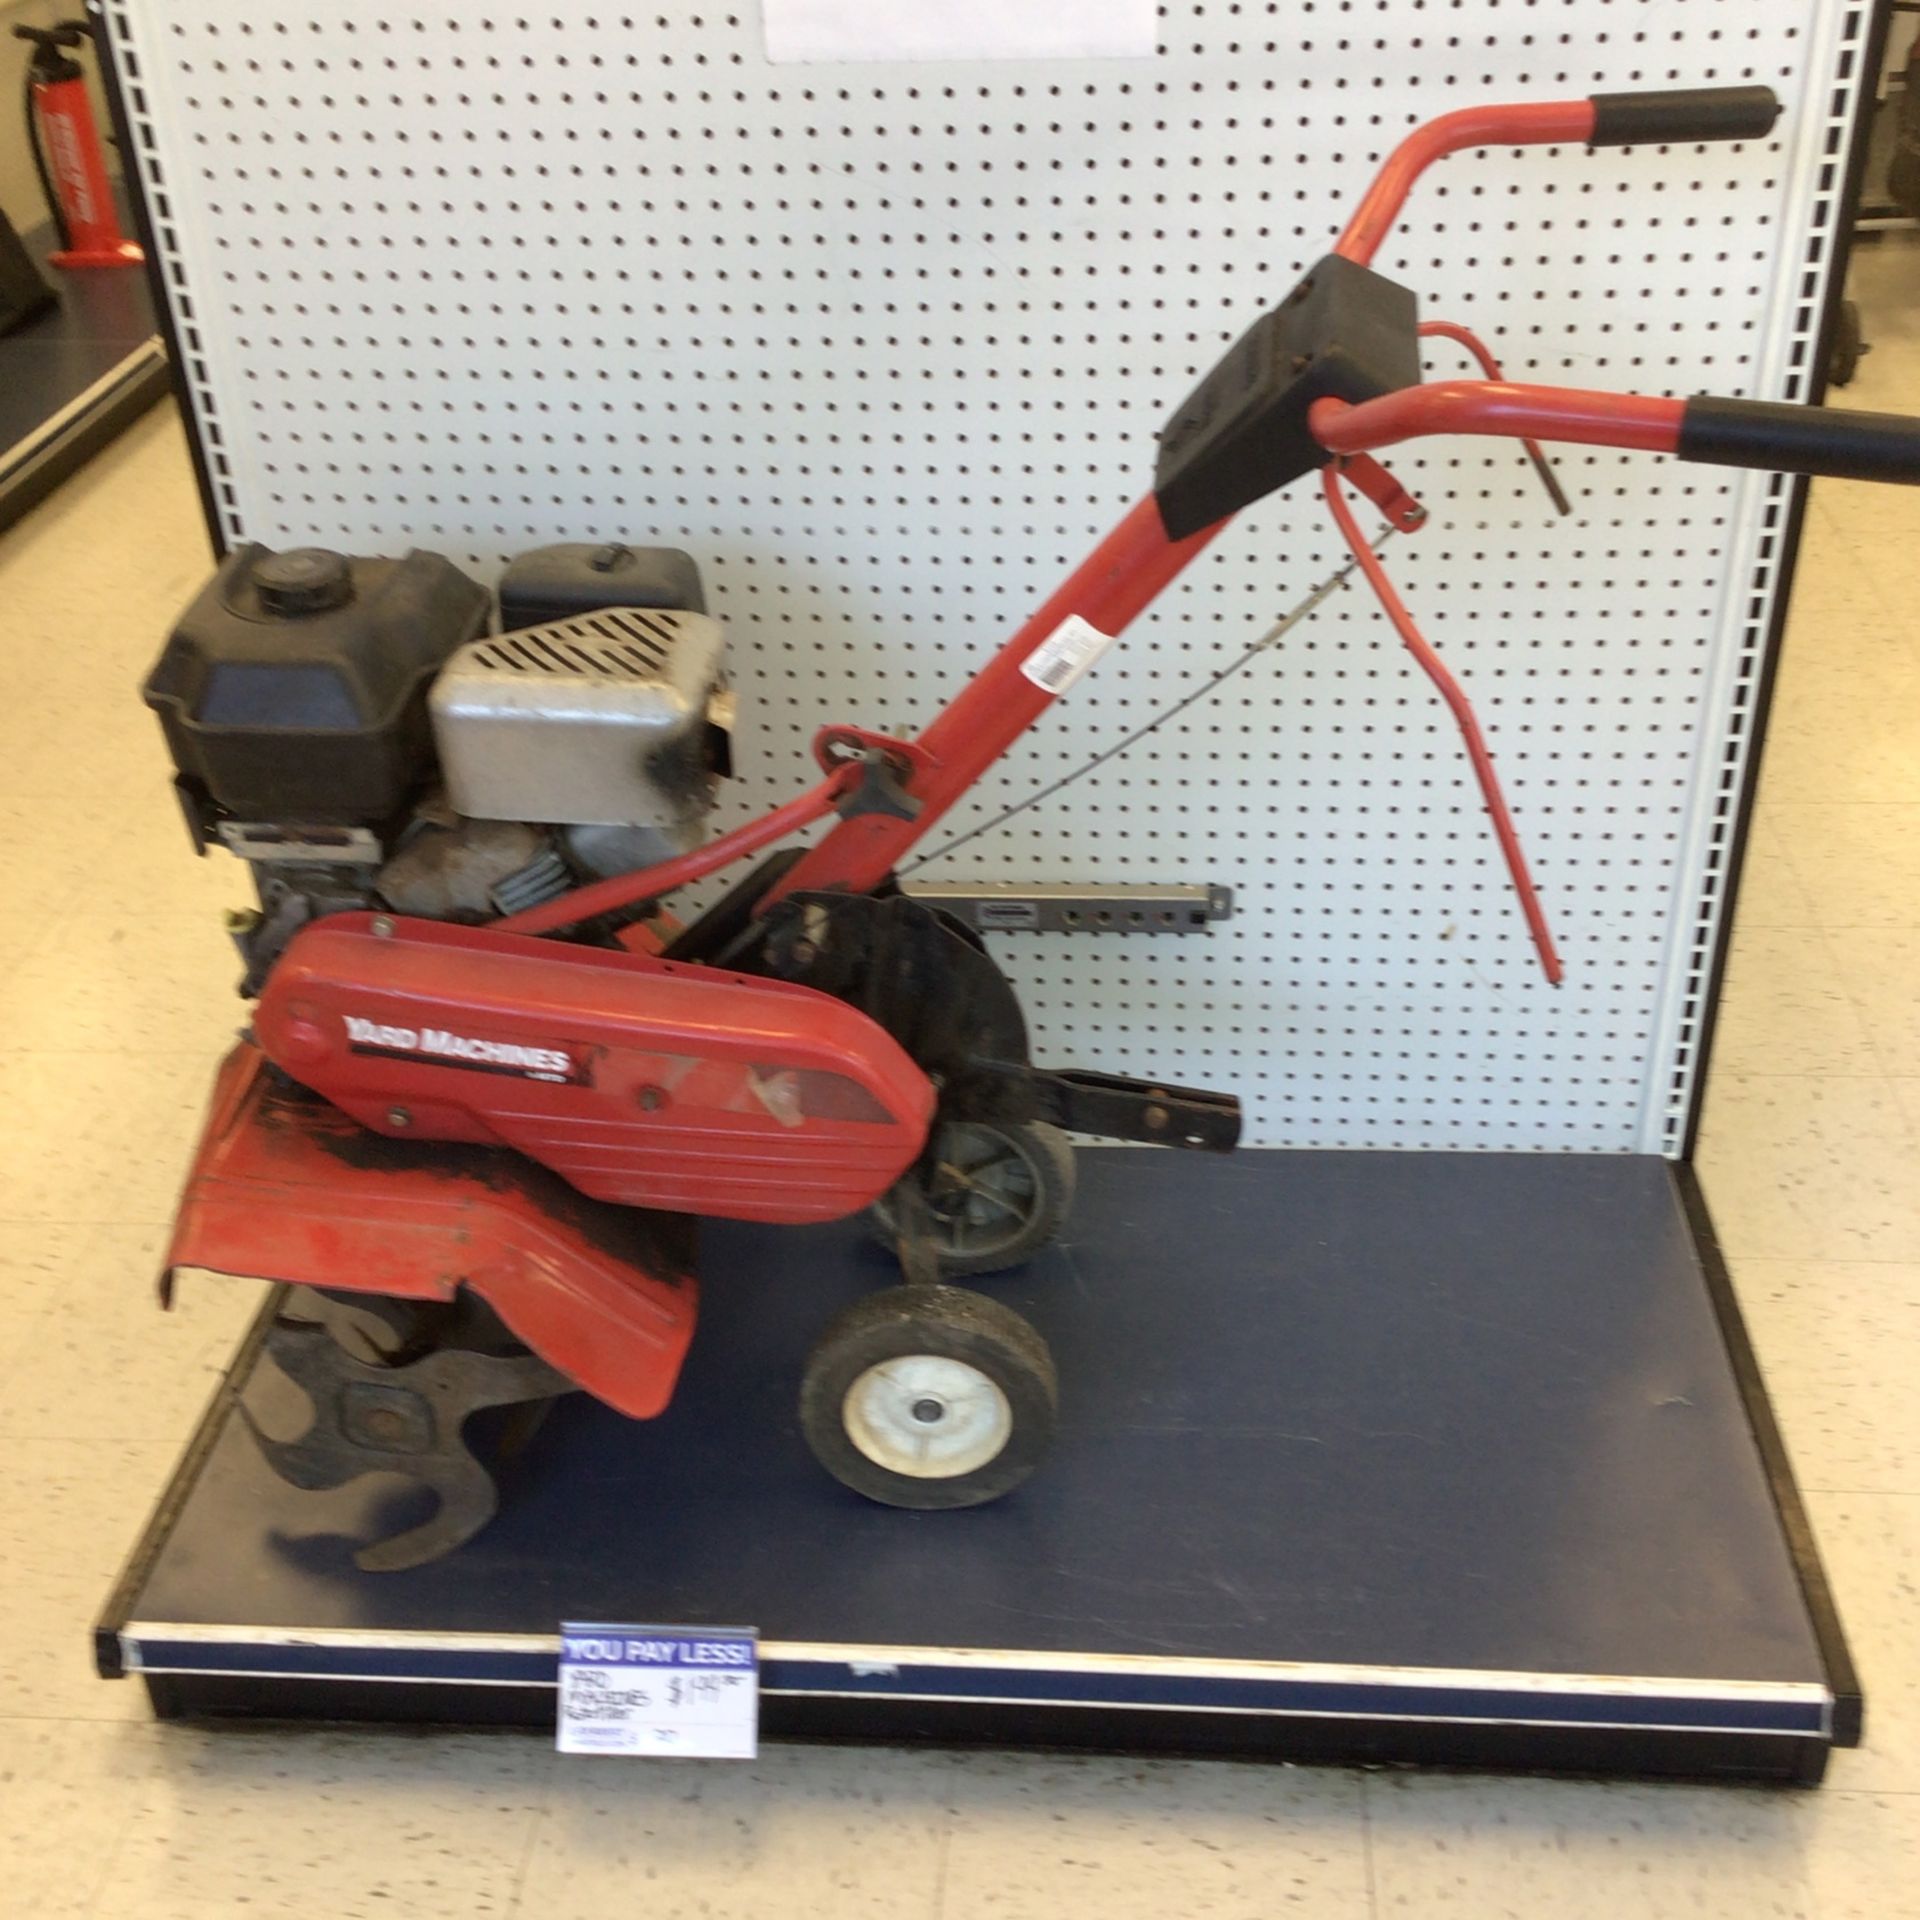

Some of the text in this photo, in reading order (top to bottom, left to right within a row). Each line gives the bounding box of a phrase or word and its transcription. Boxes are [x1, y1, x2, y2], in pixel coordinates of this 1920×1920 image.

[342, 1014, 571, 1072] YARD MACHINES
[564, 1638, 751, 1664] YOU PAY LESS!
